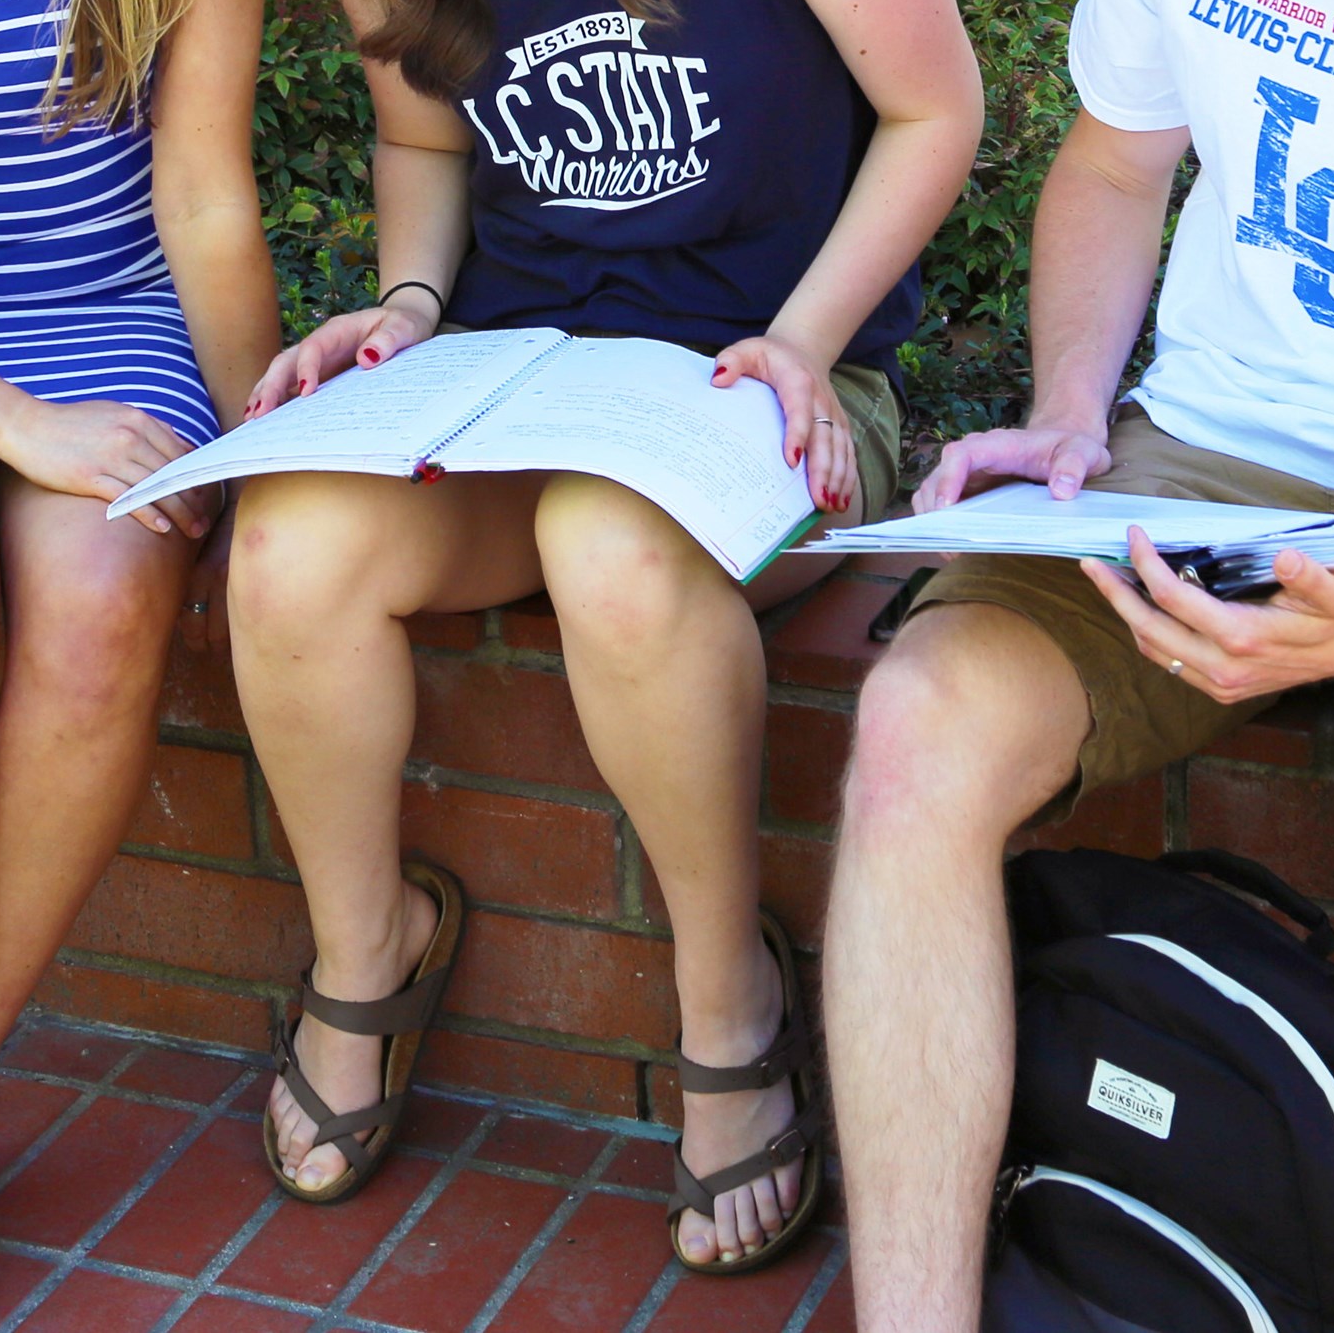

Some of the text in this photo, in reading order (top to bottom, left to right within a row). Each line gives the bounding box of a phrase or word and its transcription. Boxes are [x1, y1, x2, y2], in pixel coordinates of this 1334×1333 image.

[529, 16, 626, 61] EST. 1893
[462, 51, 721, 165] LC STATE
[517, 146, 710, 198] Warriors
[1098, 1085, 1163, 1122] QUIKSILVER
